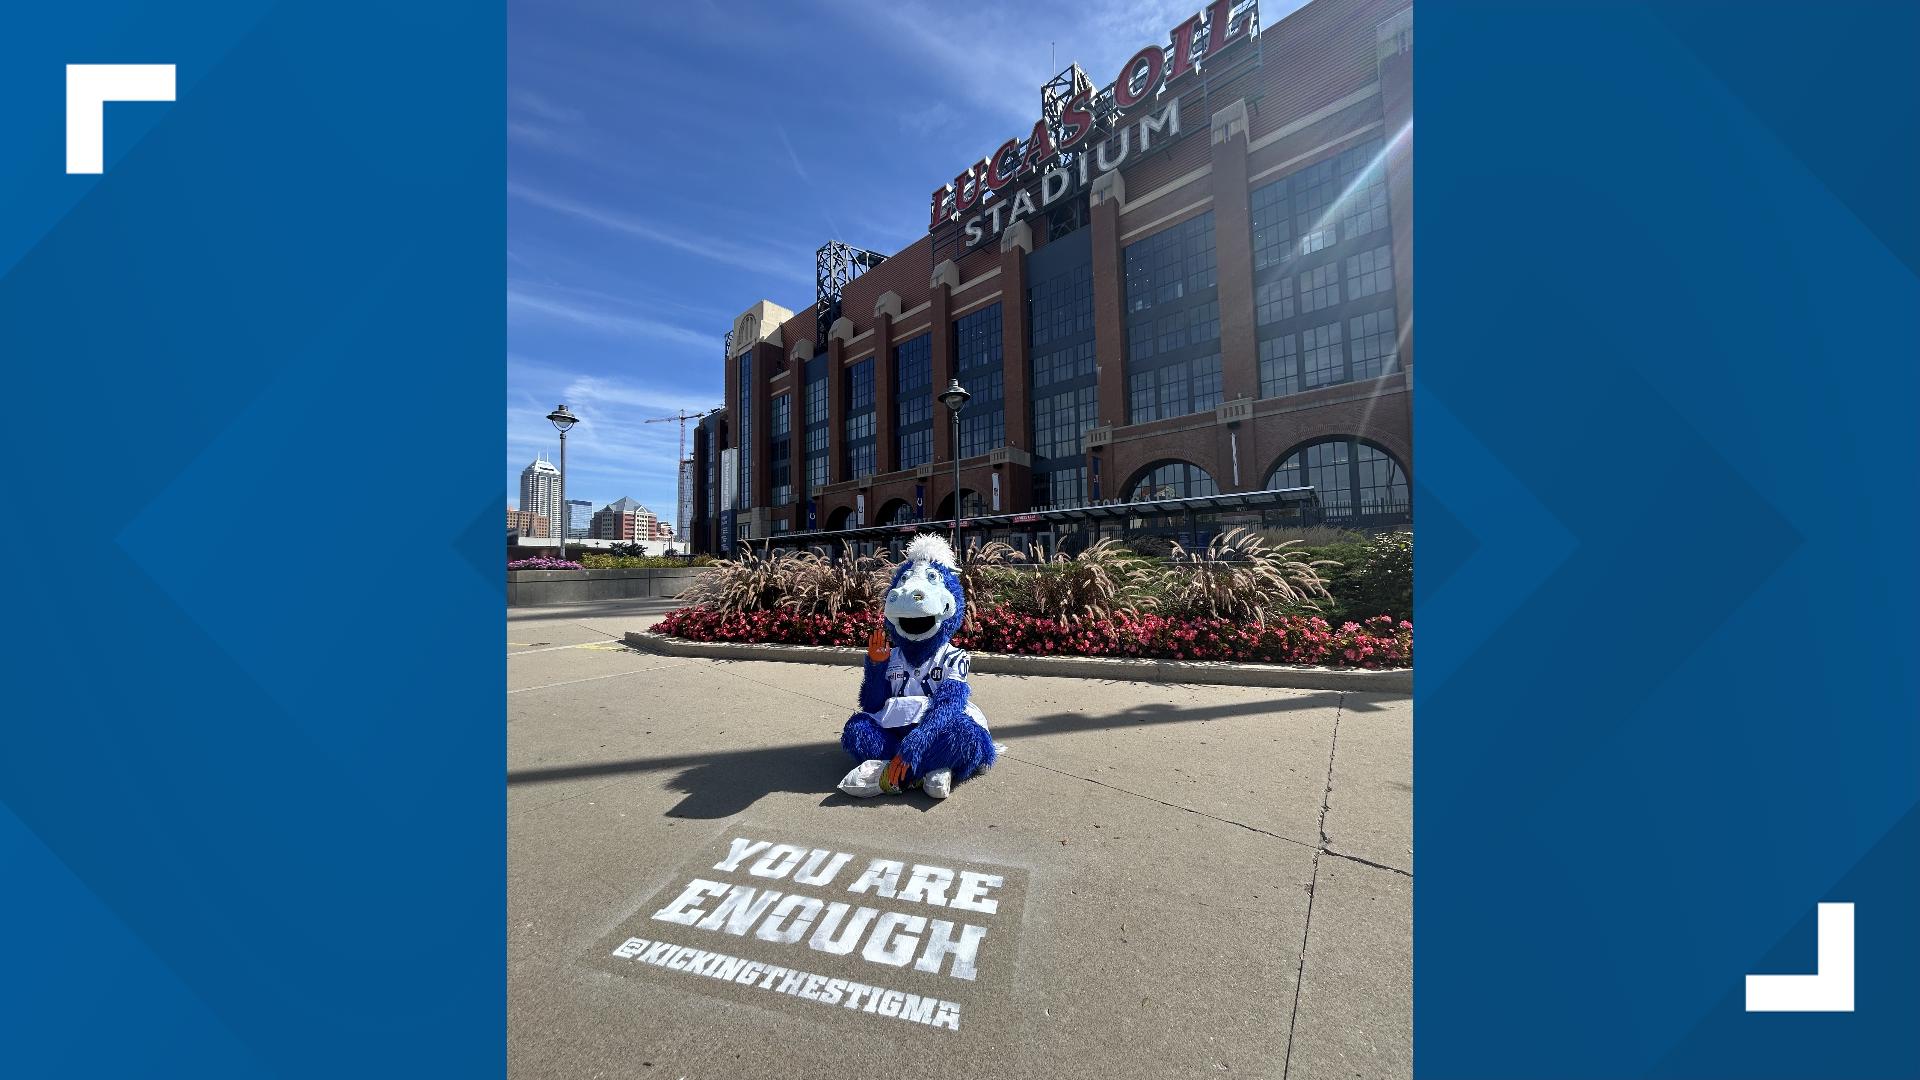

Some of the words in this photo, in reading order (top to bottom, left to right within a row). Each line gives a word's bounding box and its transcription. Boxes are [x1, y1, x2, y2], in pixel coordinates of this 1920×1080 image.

[930, 88, 1093, 230] LUCAS
[1114, 0, 1253, 109] OIL
[965, 97, 1180, 247] STADIUM
[713, 837, 854, 887] YOU
[847, 858, 1003, 915] ARE
[651, 878, 987, 982] ENOUGH
[612, 936, 961, 1032] @KICKINGTHESTIGMA
